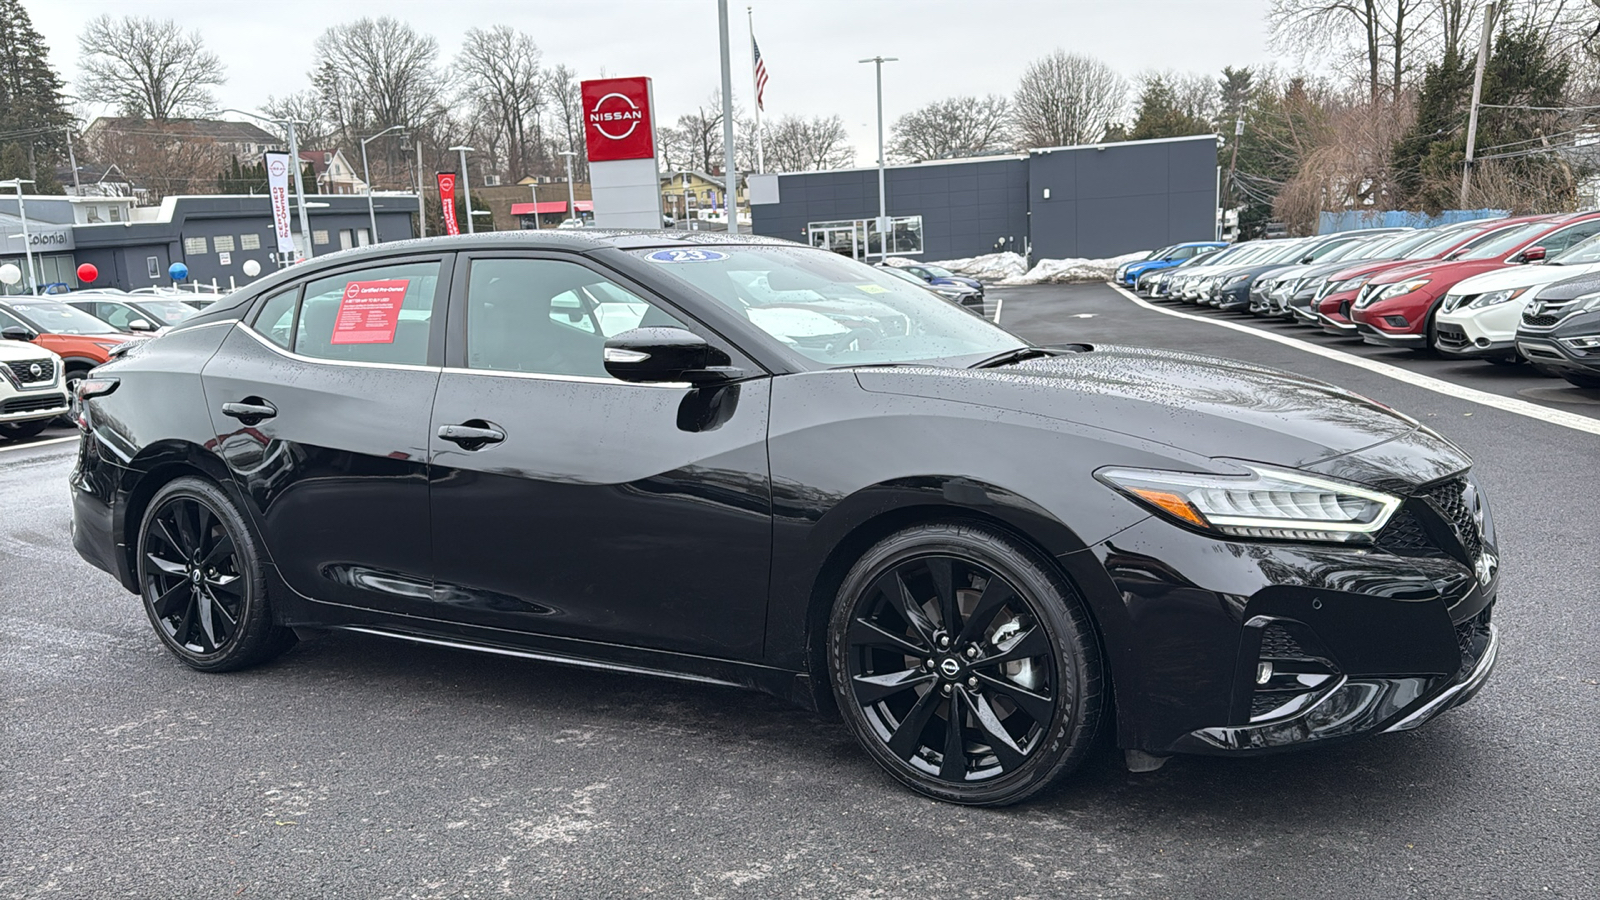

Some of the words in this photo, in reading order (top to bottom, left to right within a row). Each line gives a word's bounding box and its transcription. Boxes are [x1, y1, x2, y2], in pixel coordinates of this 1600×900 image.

[590, 111, 641, 122] NISSAN
[272, 186, 284, 238] CERTIFIED
[278, 187, 289, 238] Pre-Owned
[28, 231, 67, 245] Colonial
[669, 250, 707, 261] 23
[1051, 637, 1073, 752] GOODYEAR
